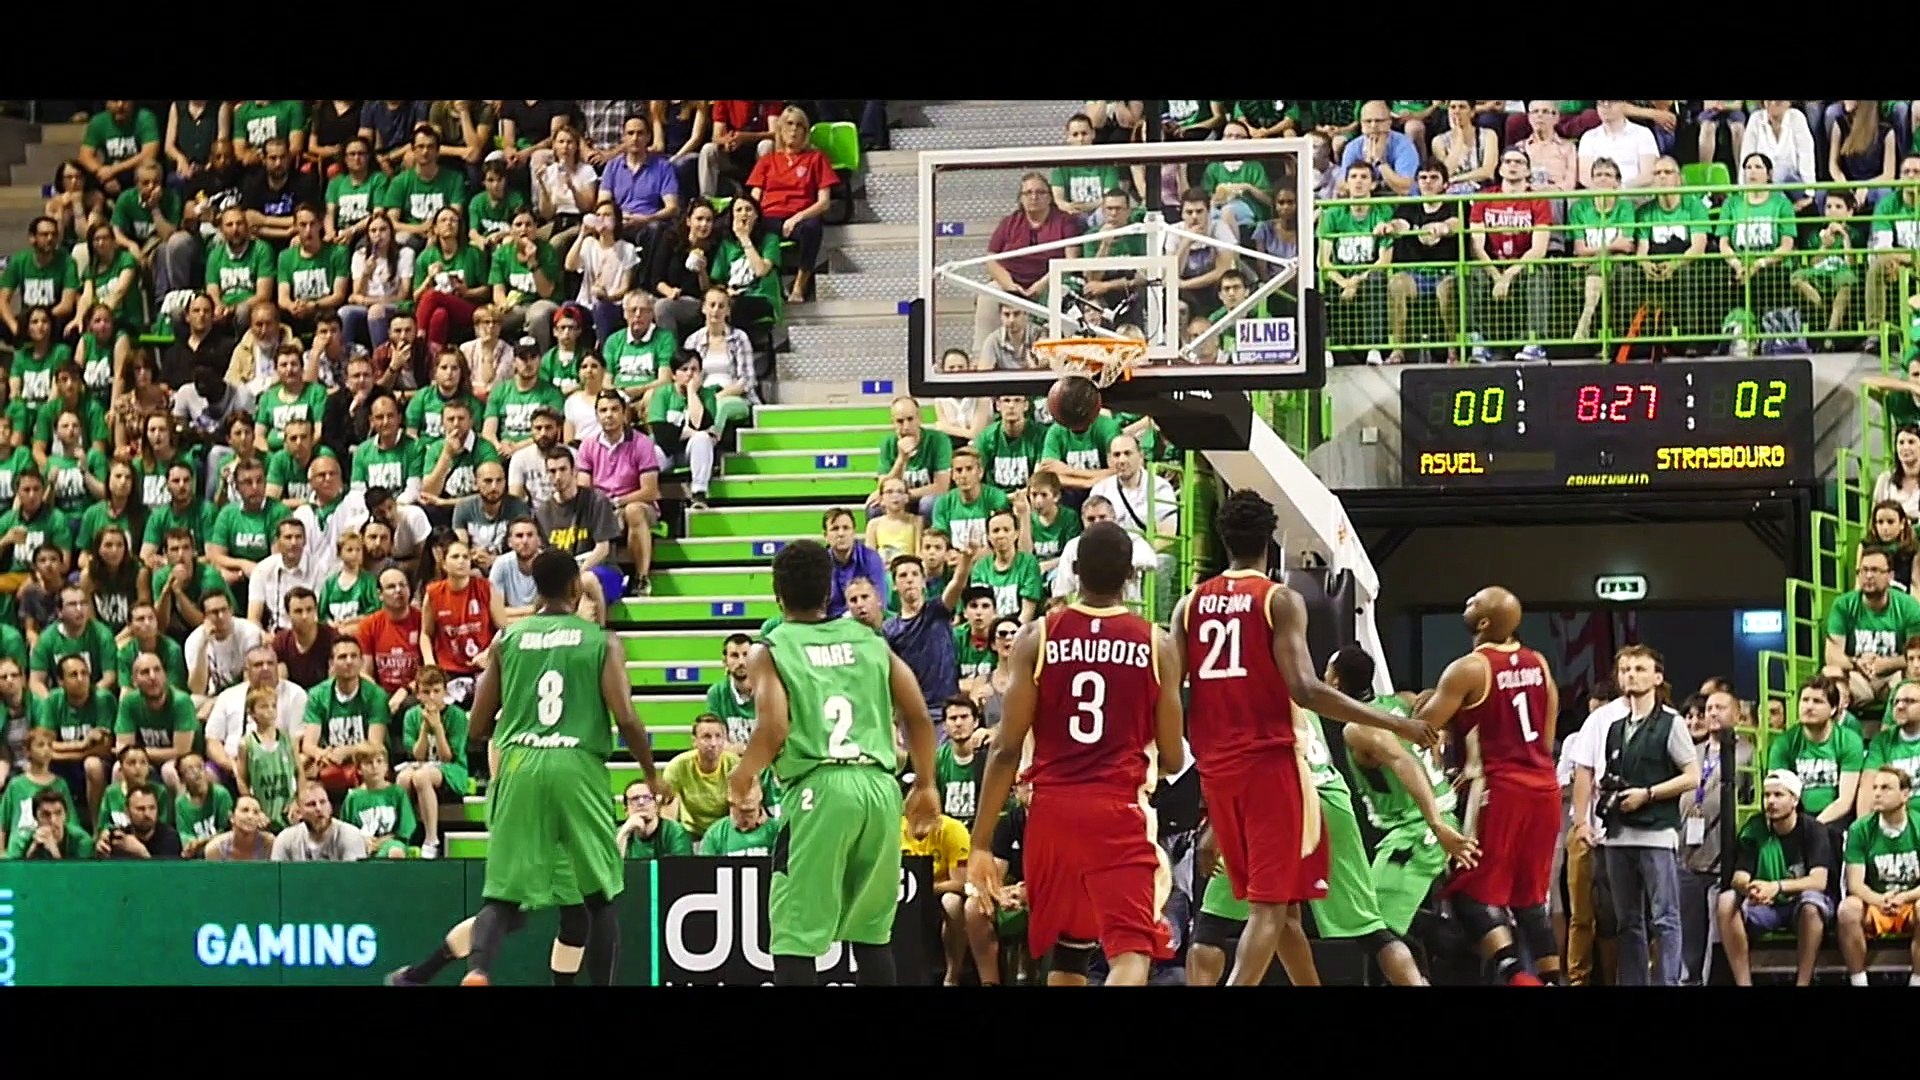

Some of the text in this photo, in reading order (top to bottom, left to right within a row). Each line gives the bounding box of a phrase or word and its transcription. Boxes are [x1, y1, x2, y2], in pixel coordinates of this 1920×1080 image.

[942, 223, 954, 234] K
[1252, 322, 1290, 343] LNB
[1453, 387, 1505, 427] 00
[1576, 384, 1657, 421] 8:27
[1734, 380, 1787, 419] 02
[824, 455, 838, 467] H
[1420, 445, 1785, 475] ASVEL STRASBOURG
[722, 603, 733, 615] F
[805, 643, 856, 668] WARE
[1045, 637, 1151, 668] BEAUBOIS
[1198, 617, 1248, 680] 21
[538, 669, 564, 726] 8
[1069, 670, 1106, 744] 3
[824, 695, 860, 759] 2
[1511, 691, 1540, 743] 1
[801, 787, 814, 811] 2
[196, 923, 377, 967] GAMING
